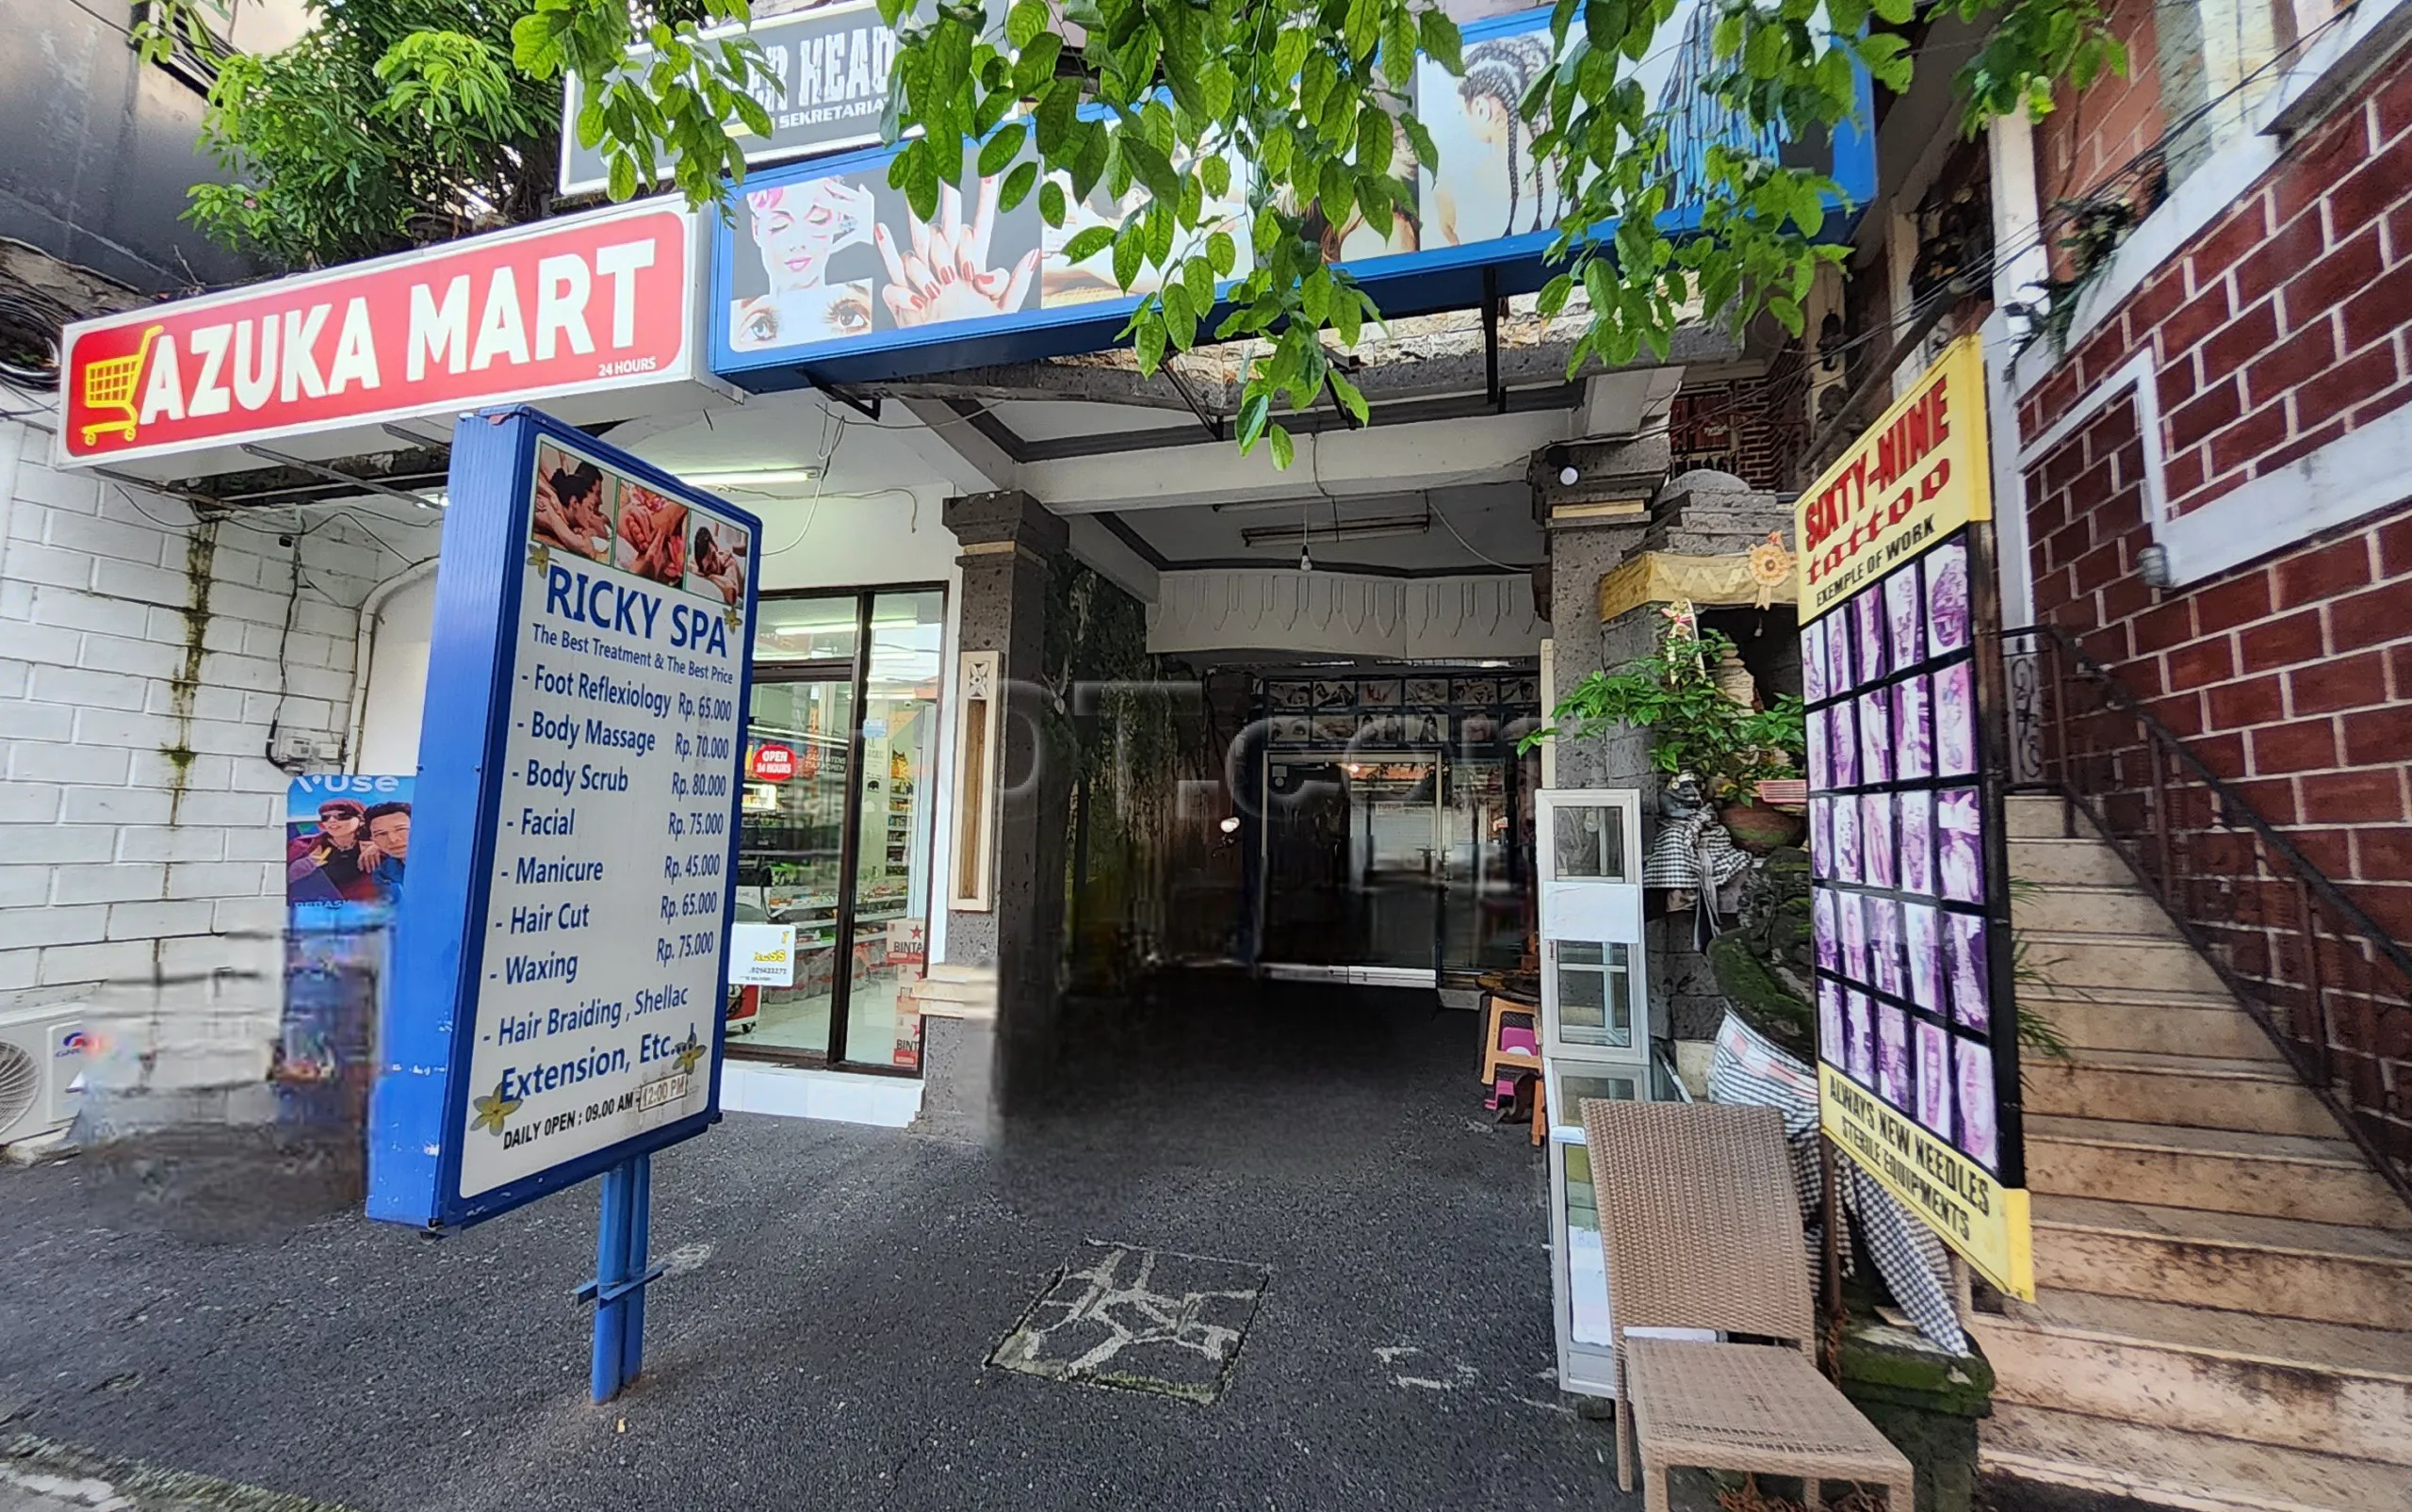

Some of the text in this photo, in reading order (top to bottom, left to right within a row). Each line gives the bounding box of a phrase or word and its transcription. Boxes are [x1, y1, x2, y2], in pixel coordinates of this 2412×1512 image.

[798, 25, 896, 107] HEAD
[779, 97, 889, 129] SEKRETARIA
[140, 238, 656, 425] AZUKA MART
[597, 356, 657, 377] 24 HOURS
[1805, 373, 1951, 552] SIXTY-NINE
[1817, 513, 1935, 608] EXEMPLE OF WORK
[546, 563, 727, 658] RICKY SPA
[532, 623, 733, 685] The Best Treatment & The Best Price
[534, 663, 732, 722] Foot Reflexiology Rp. 65.000
[531, 711, 729, 763] Body Massage Rp. 70.000
[761, 751, 788, 762] OPEN
[526, 758, 726, 802] Body Scrub Rp. 80.000
[757, 763, 791, 774] 24 HOURS
[520, 807, 724, 841] Facial Rp. 75.000
[515, 854, 721, 886] Manicure Rp. 45.000
[510, 891, 717, 935] Hair Cut Rp. 65.000
[506, 931, 714, 984] Waxing Rp. 75.000
[497, 984, 689, 1047] Hair Braiding Shellac
[499, 1046, 631, 1103] Extension,
[503, 1121, 542, 1150] DAILY
[544, 1110, 575, 1136] OPEN
[585, 1098, 615, 1123] 09.00
[617, 1092, 634, 1112] AM
[670, 1076, 685, 1097] PM
[1830, 1074, 1990, 1217] ALWAYS NEW NEEDLES
[1841, 1115, 1970, 1242] STERILE EQUIPMENTS
